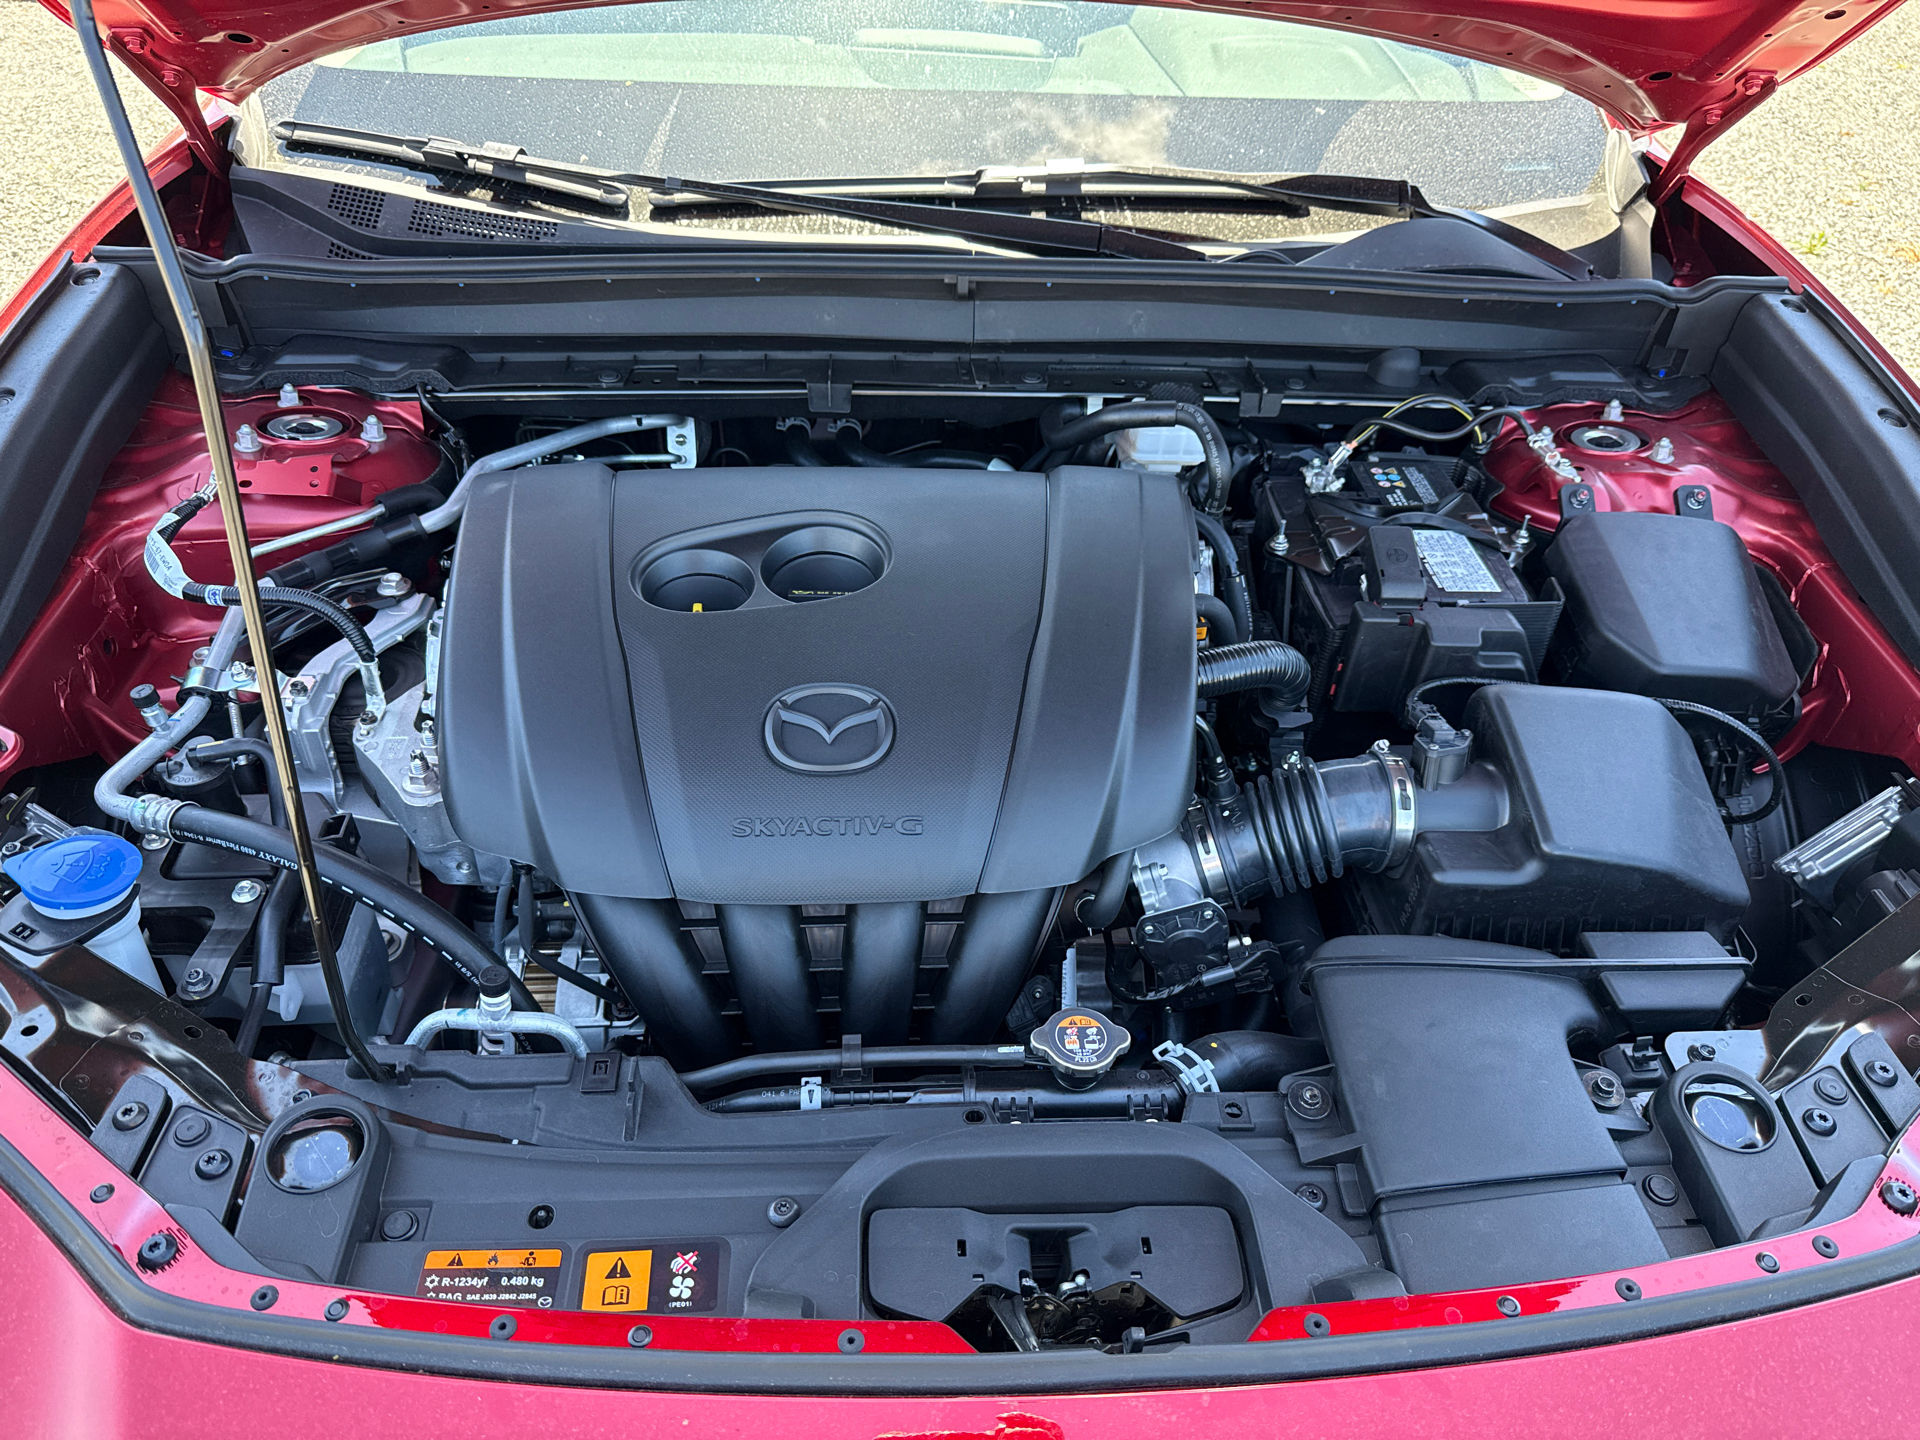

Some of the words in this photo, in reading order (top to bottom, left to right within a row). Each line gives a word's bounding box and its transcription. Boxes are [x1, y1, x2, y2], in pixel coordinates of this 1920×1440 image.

[731, 815, 924, 838] SKYACTIV-G
[258, 851, 299, 871] GALAXY
[441, 1276, 488, 1288] R-1234yf
[501, 1276, 529, 1287] 0.480
[529, 1275, 545, 1289] kg
[466, 1293, 481, 1301] SAE
[668, 1300, 693, 1308] (PE01)
